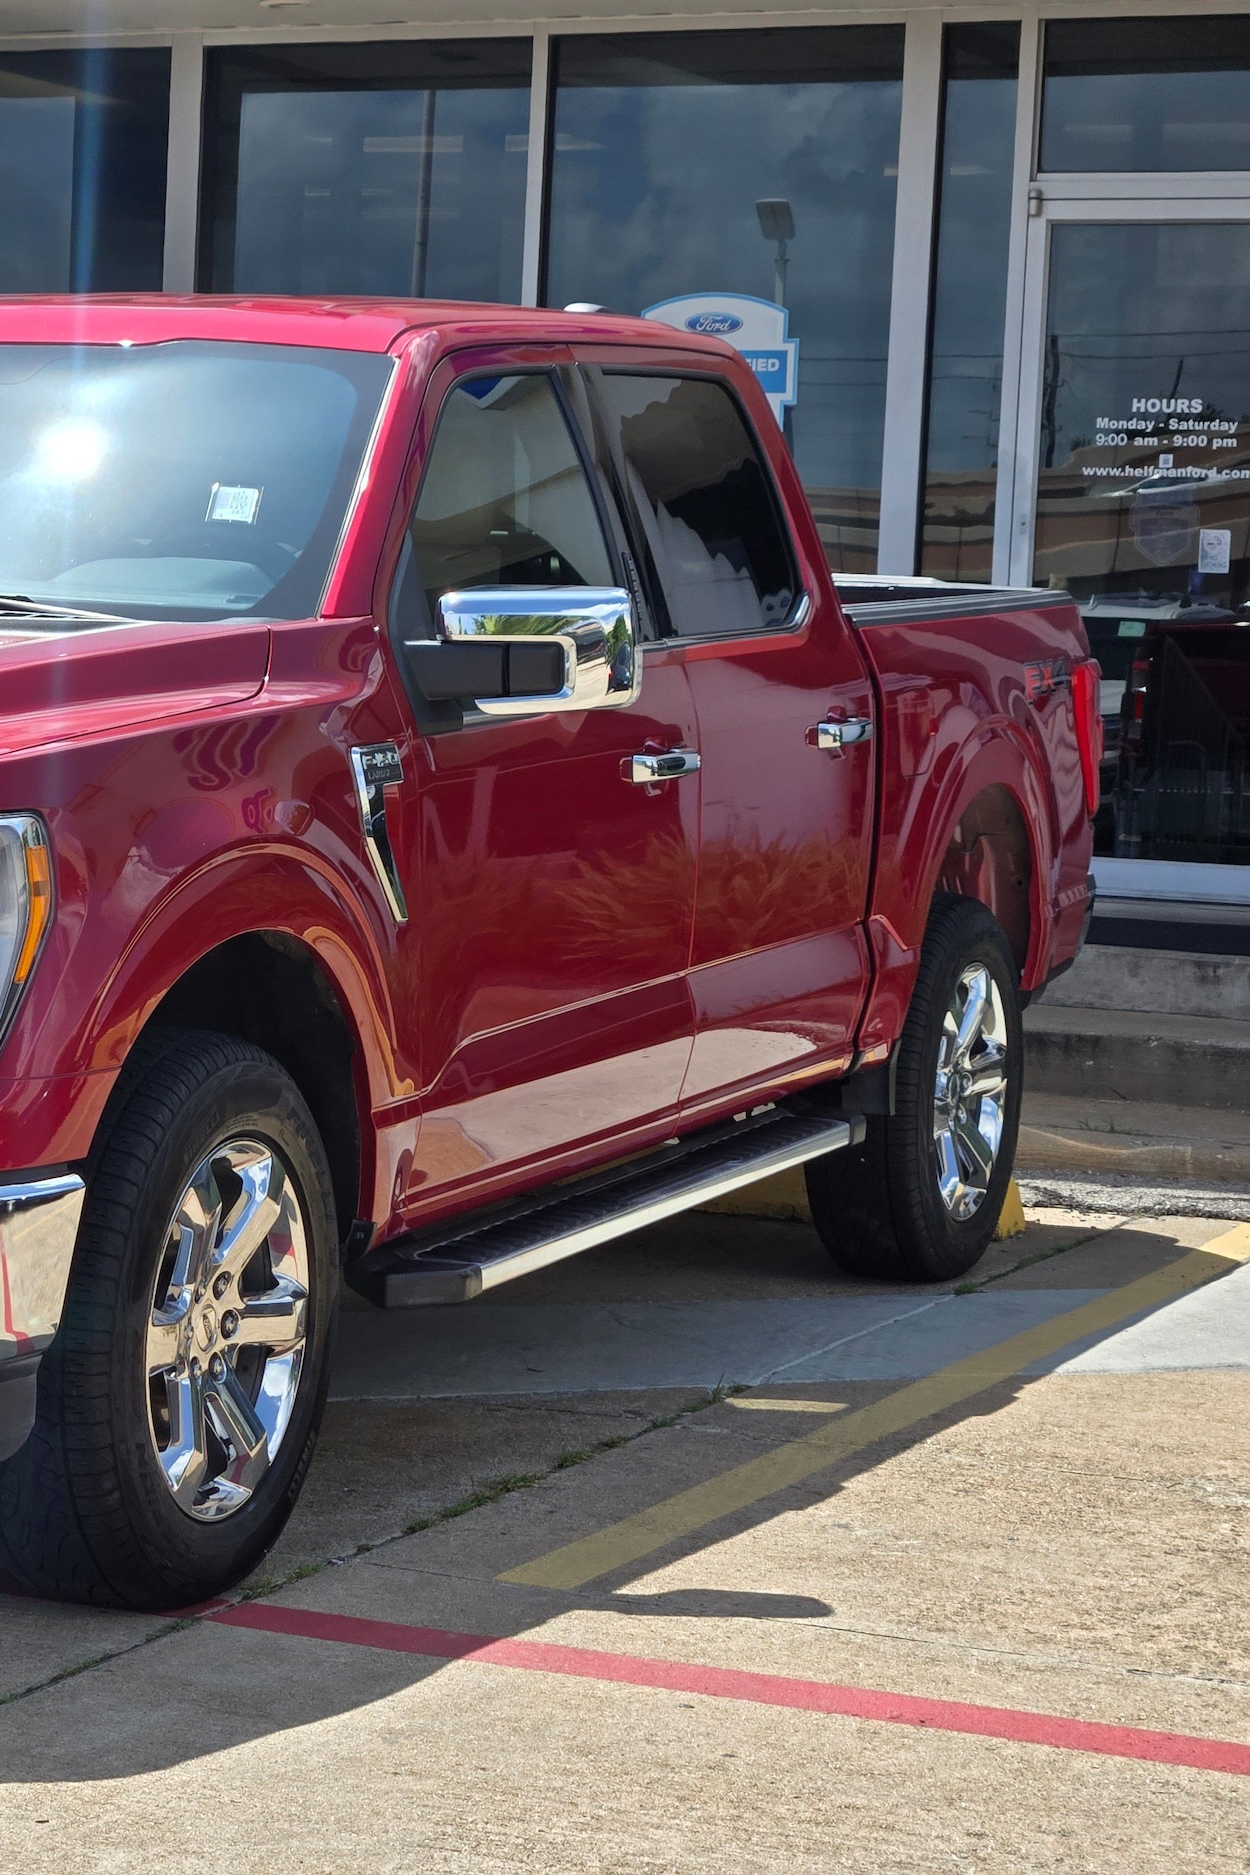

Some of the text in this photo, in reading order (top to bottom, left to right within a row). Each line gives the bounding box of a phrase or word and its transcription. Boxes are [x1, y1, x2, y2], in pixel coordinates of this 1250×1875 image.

[695, 314, 731, 332] Ford
[1131, 398, 1204, 414] HOURS
[1096, 417, 1155, 432] Monday
[1168, 418, 1239, 434] Saturday
[1095, 433, 1128, 446] 9:00
[1133, 436, 1158, 447] am
[1172, 435, 1208, 447] 9:00
[1212, 437, 1238, 450] pm
[1023, 657, 1071, 705] FX4
